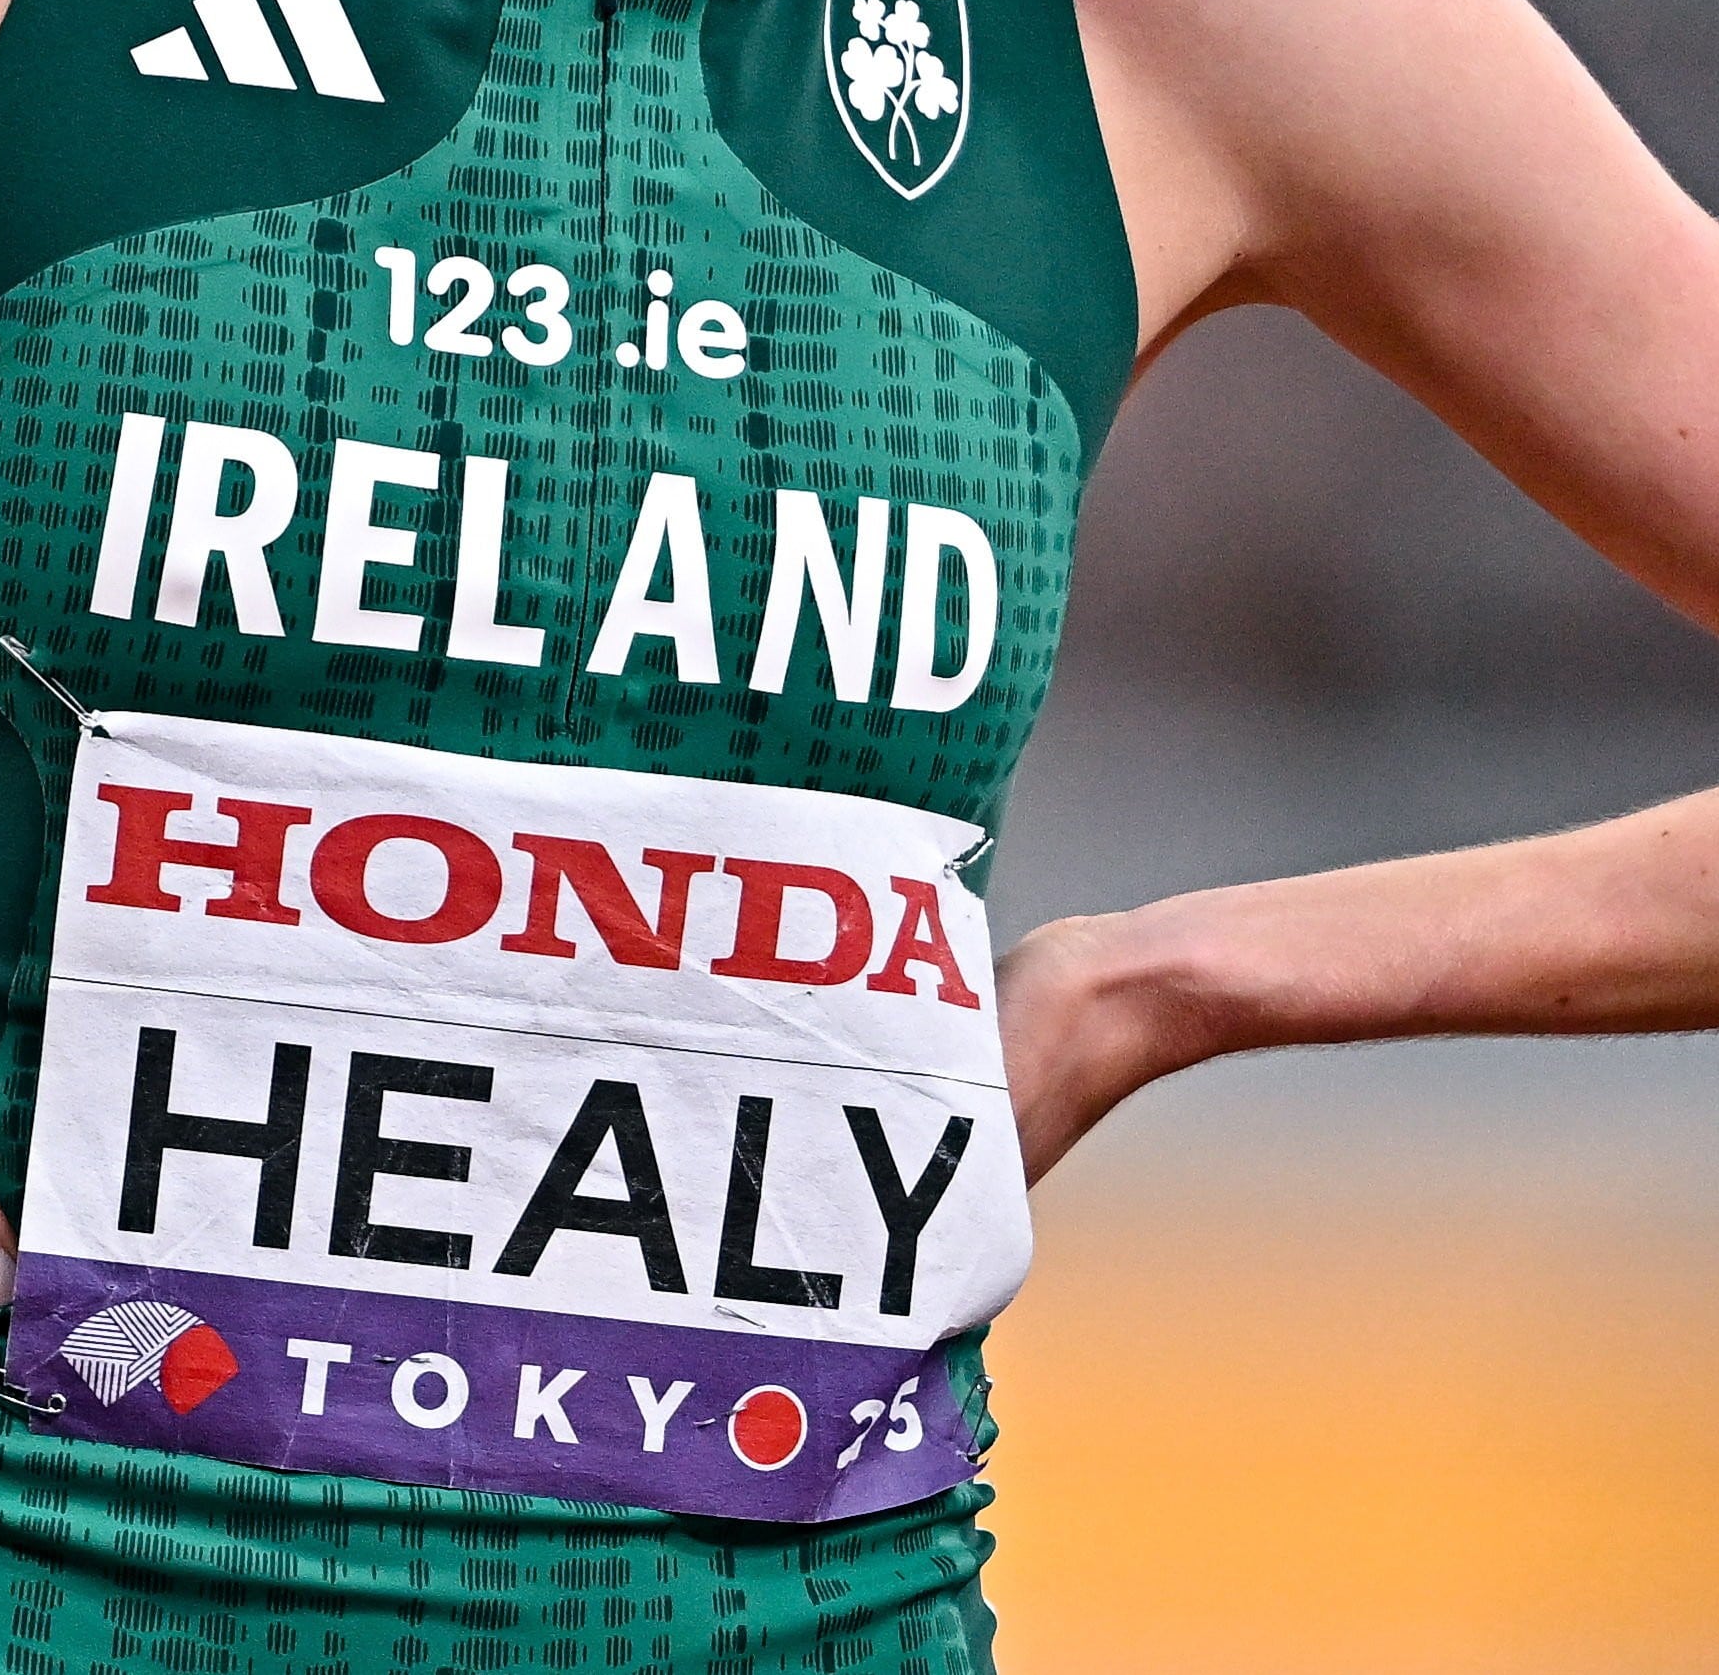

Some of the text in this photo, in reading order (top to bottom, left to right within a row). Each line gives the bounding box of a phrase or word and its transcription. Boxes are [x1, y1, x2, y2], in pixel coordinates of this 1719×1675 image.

[89, 411, 998, 713] IRELAND
[86, 783, 981, 1010] HONDA
[117, 1026, 974, 1317] HEALY
